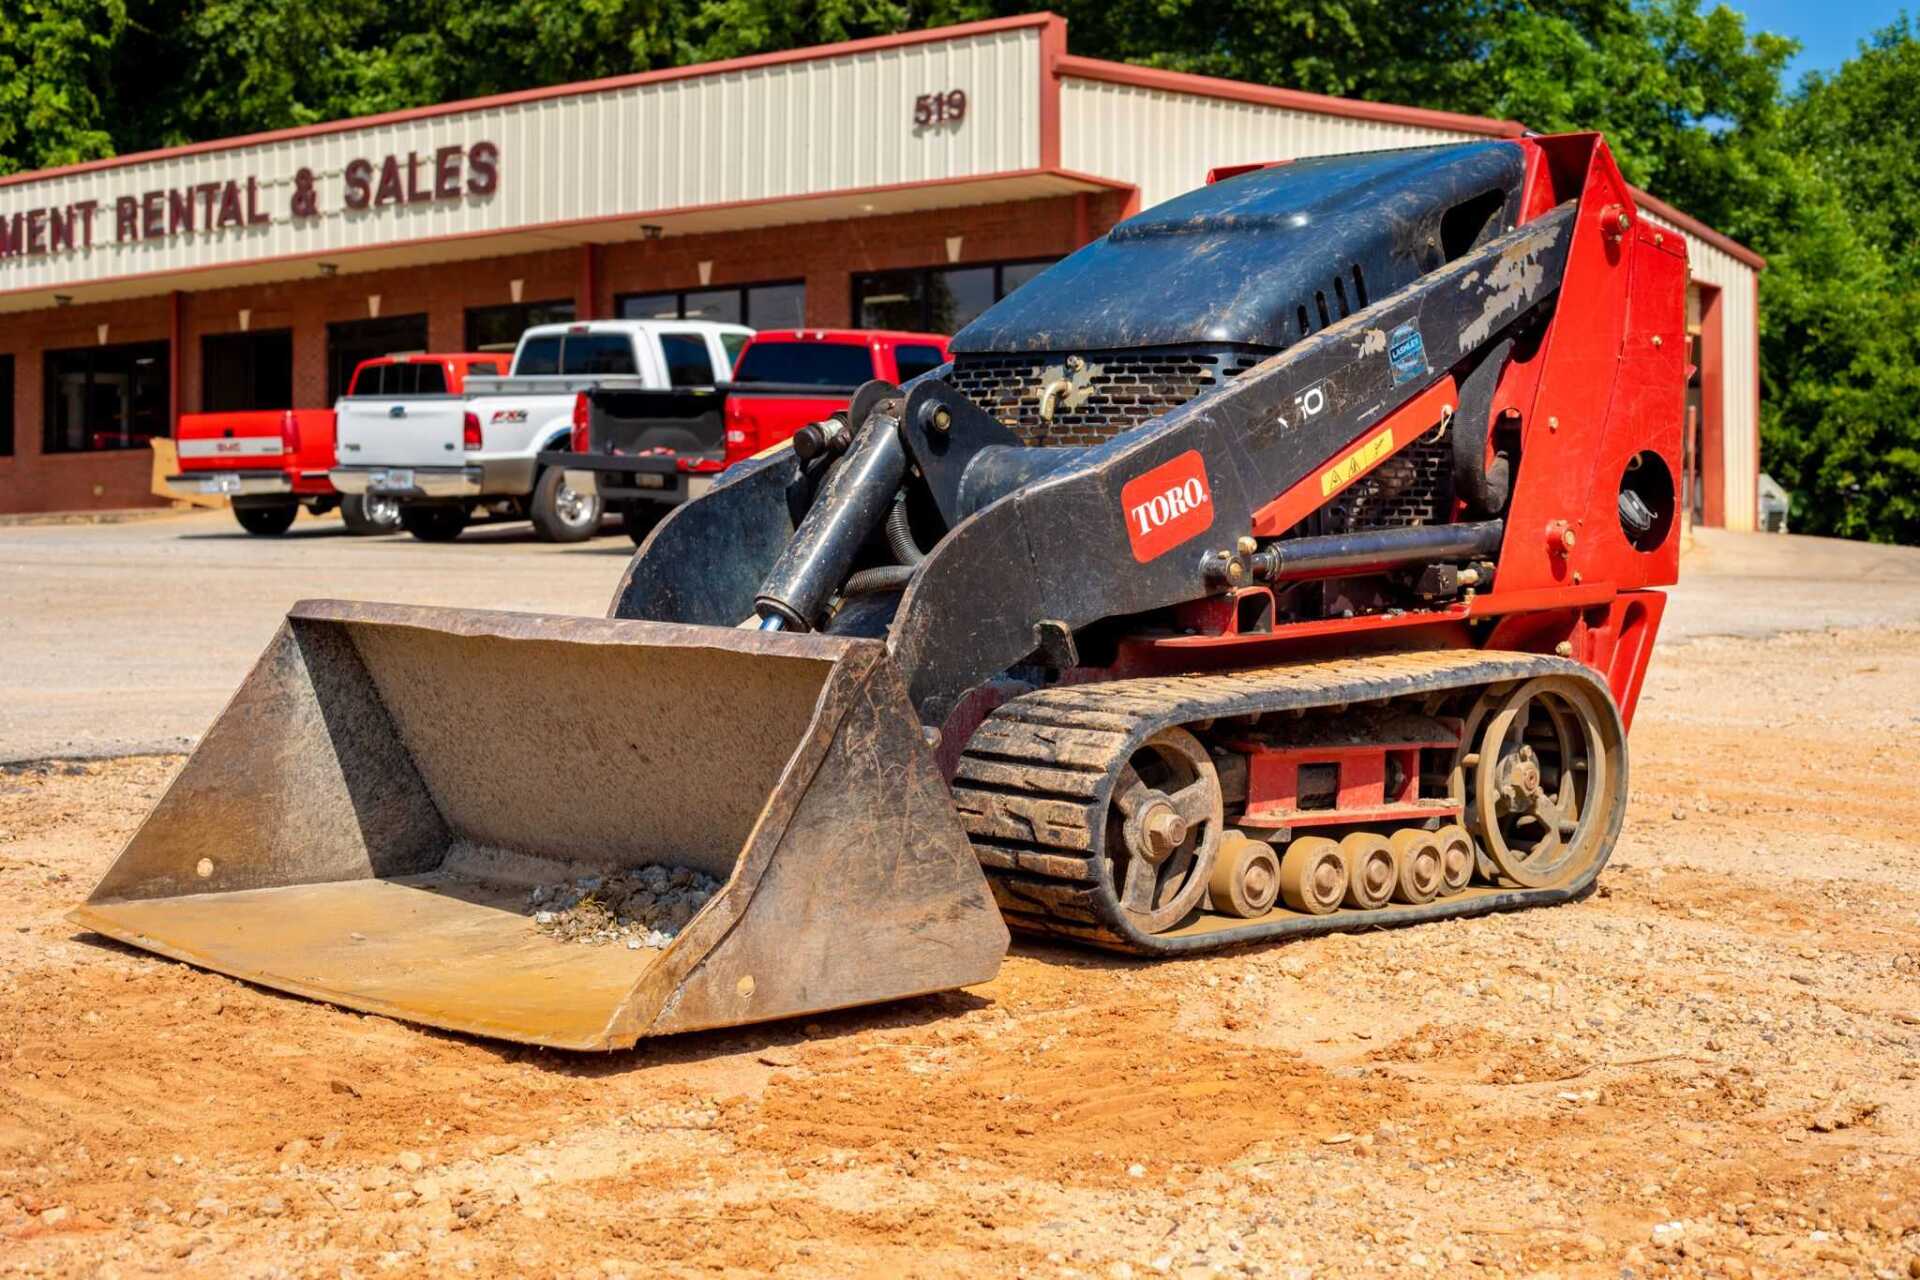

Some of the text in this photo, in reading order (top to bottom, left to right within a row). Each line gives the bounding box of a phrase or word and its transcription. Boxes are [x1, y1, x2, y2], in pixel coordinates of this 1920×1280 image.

[915, 89, 966, 126] 519
[0, 141, 499, 259] MENT RENTAL & SALES
[1131, 477, 1204, 536] TORO
